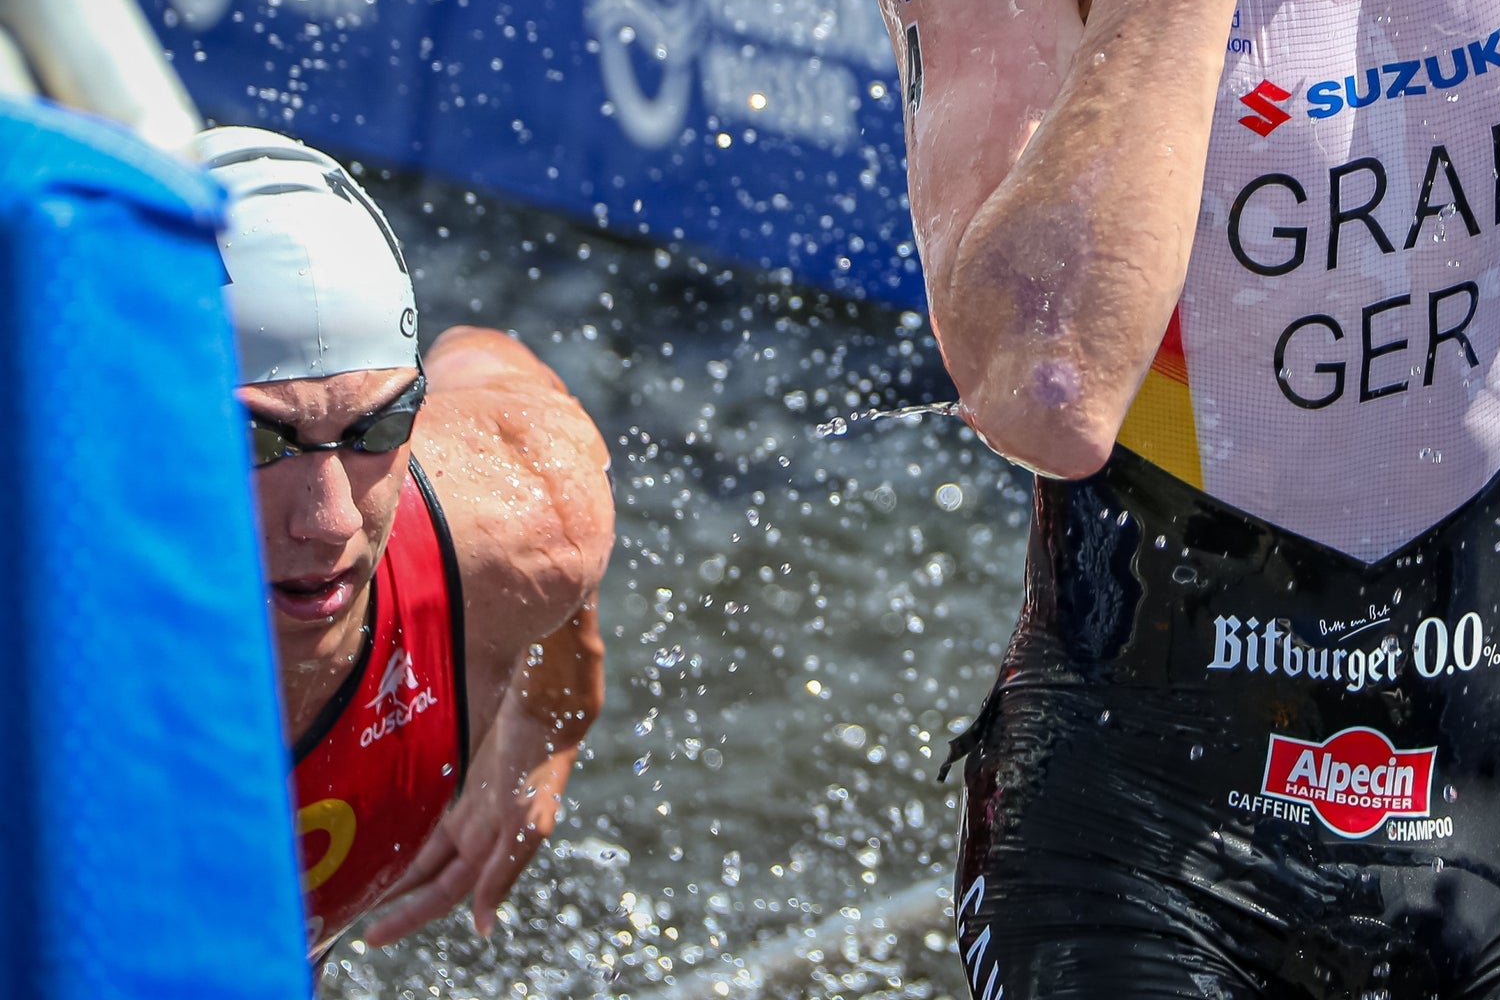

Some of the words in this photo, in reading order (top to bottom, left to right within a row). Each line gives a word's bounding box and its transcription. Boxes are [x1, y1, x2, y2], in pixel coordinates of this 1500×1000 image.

[1273, 280, 1481, 410] GER
[1207, 614, 1402, 692] Bitburger
[1285, 783, 1325, 801] HAIR
[1336, 792, 1413, 810] BOOSTER
[1286, 749, 1414, 802] Alpecin
[1228, 790, 1311, 826] CAFFEINE
